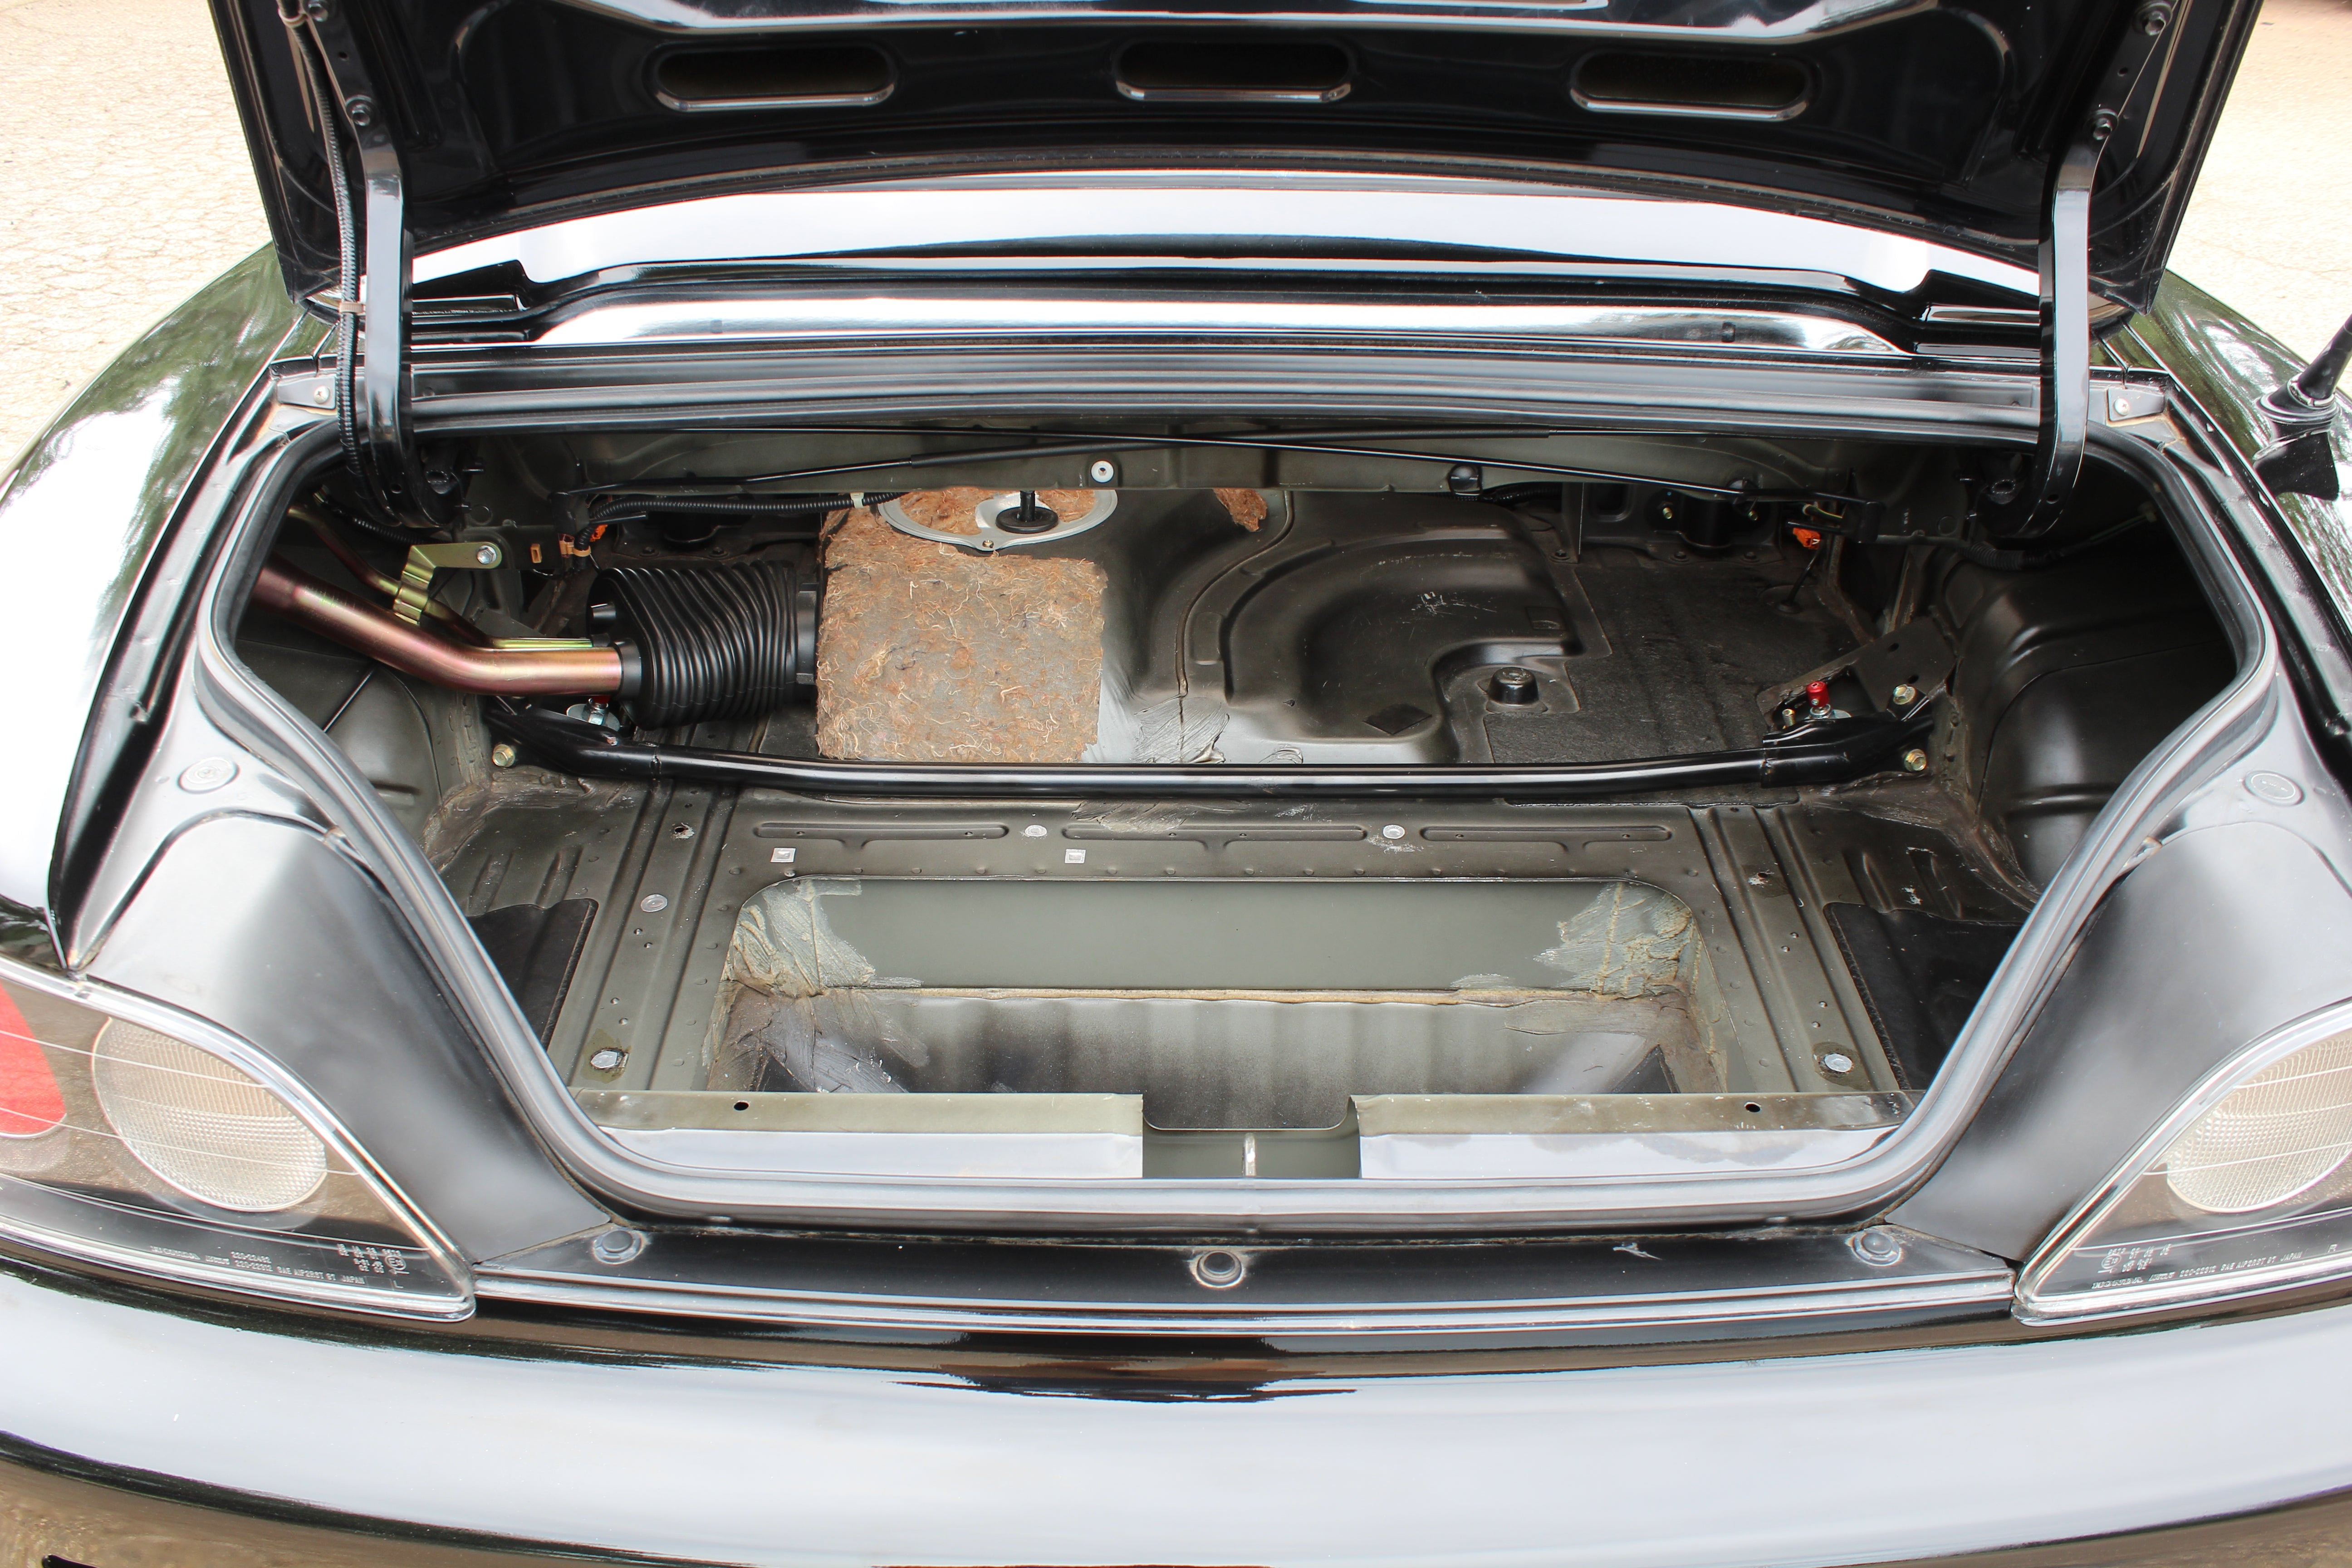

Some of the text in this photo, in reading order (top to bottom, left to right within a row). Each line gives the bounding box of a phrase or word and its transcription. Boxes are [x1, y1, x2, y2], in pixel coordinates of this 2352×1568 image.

[2328, 1244, 2338, 1253] R
[2220, 1262, 2236, 1271] SAE
[2280, 1251, 2303, 1262] JAPAN
[276, 1265, 293, 1275] SAE
[341, 1275, 365, 1284] JAPAN
